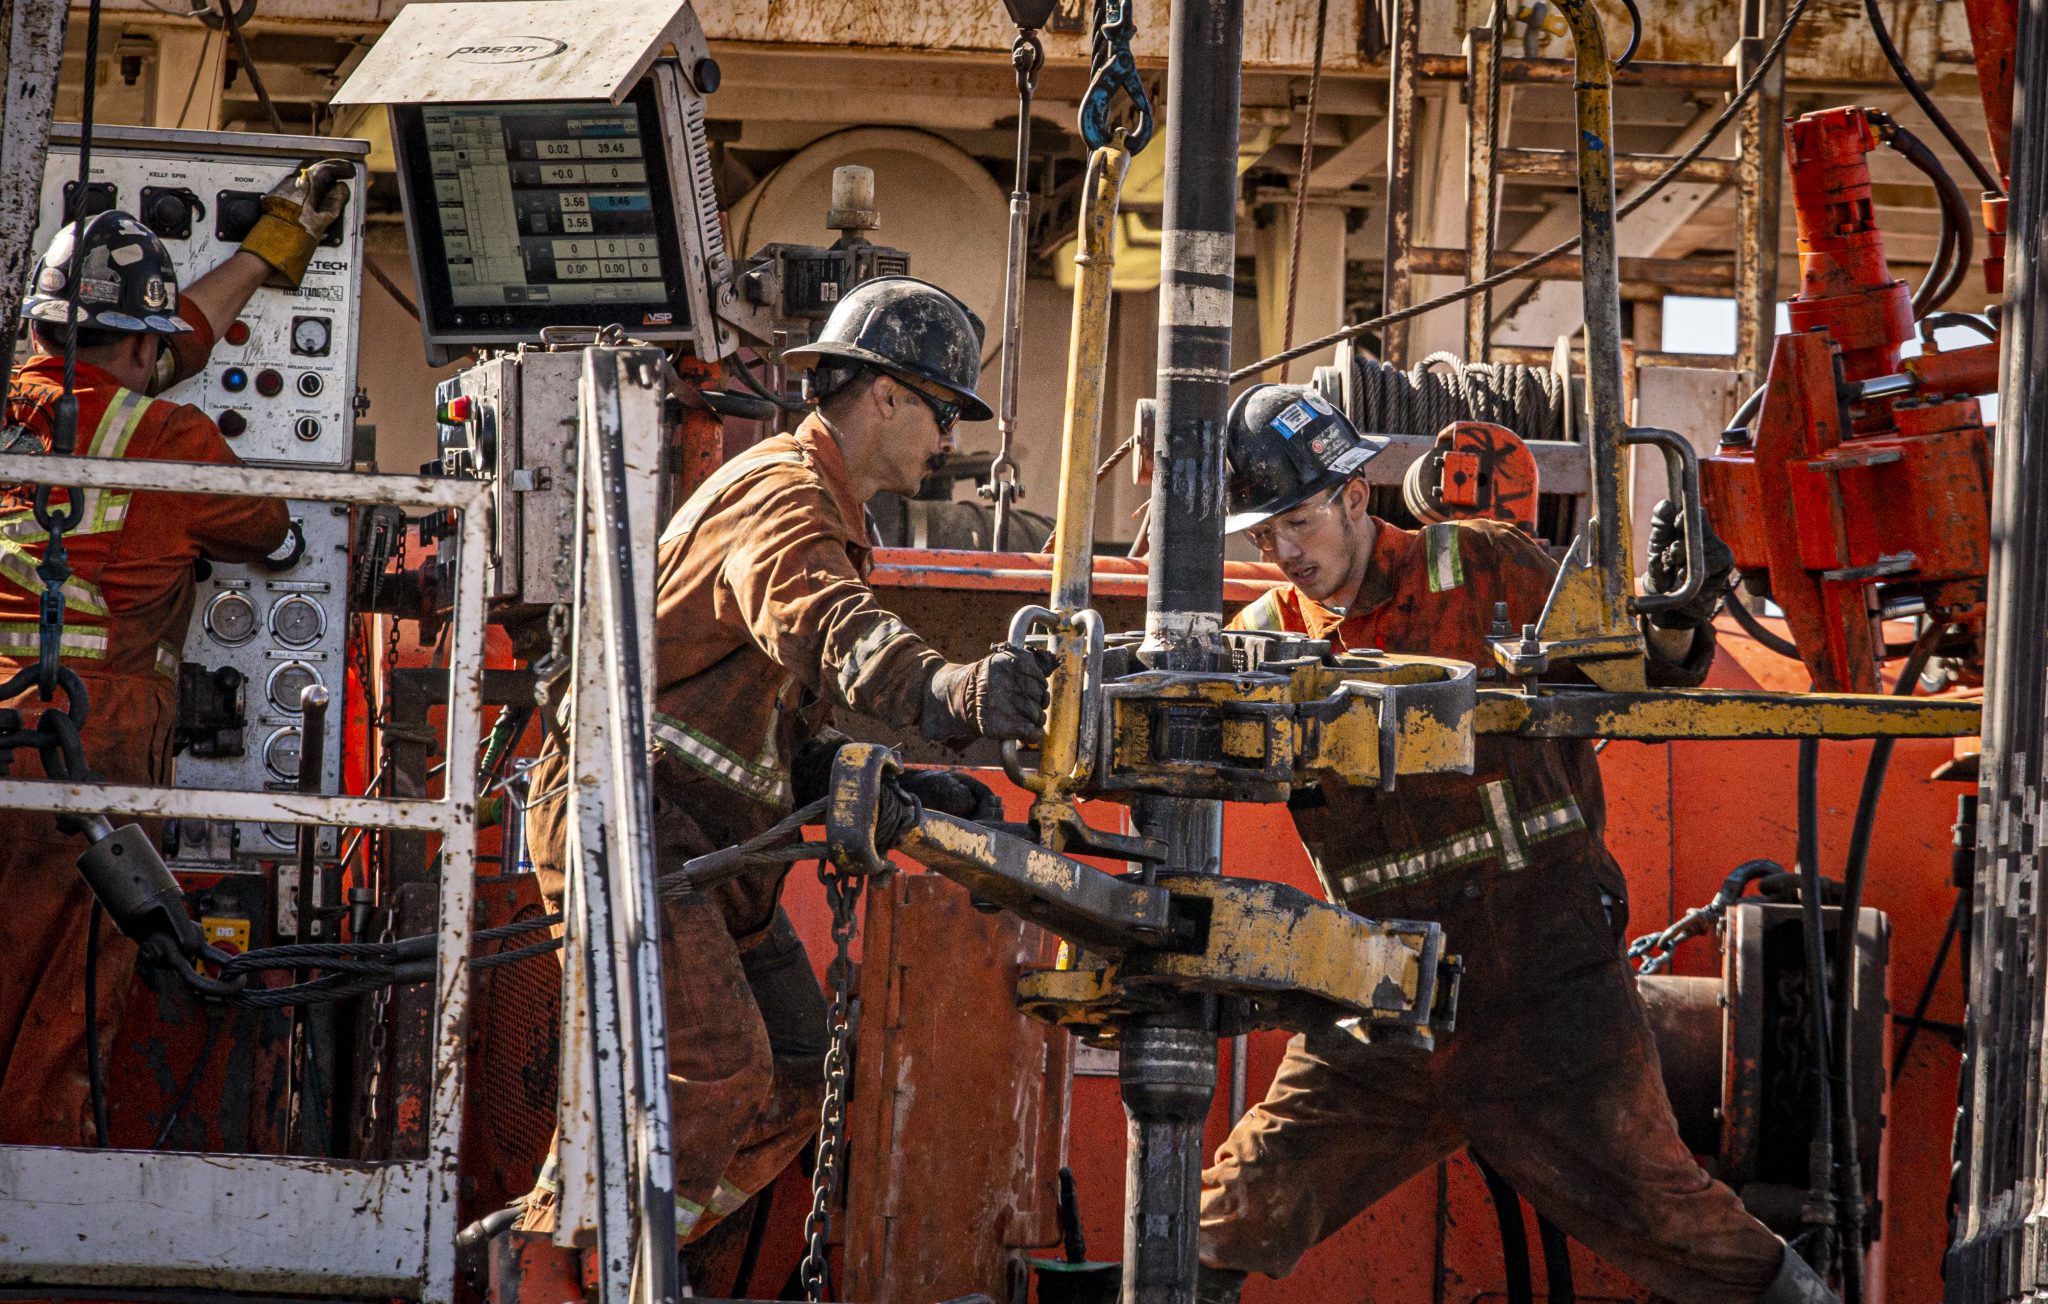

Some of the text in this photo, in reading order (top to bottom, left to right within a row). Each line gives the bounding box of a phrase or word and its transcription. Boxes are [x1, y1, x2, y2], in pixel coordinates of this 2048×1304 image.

[446, 46, 538, 58] pason
[547, 144, 569, 154] 0.02
[597, 143, 625, 153] 39.45
[552, 168, 574, 179] +0.0
[611, 168, 618, 178] 0
[564, 197, 586, 208] 3.56
[567, 217, 589, 228] 3.56
[571, 243, 578, 253] 0
[608, 244, 615, 253] 0
[638, 243, 645, 252] 0
[308, 260, 348, 271] -TECH
[604, 263, 625, 274] 0.00
[641, 263, 649, 273] 0
[647, 312, 673, 322] VSP
